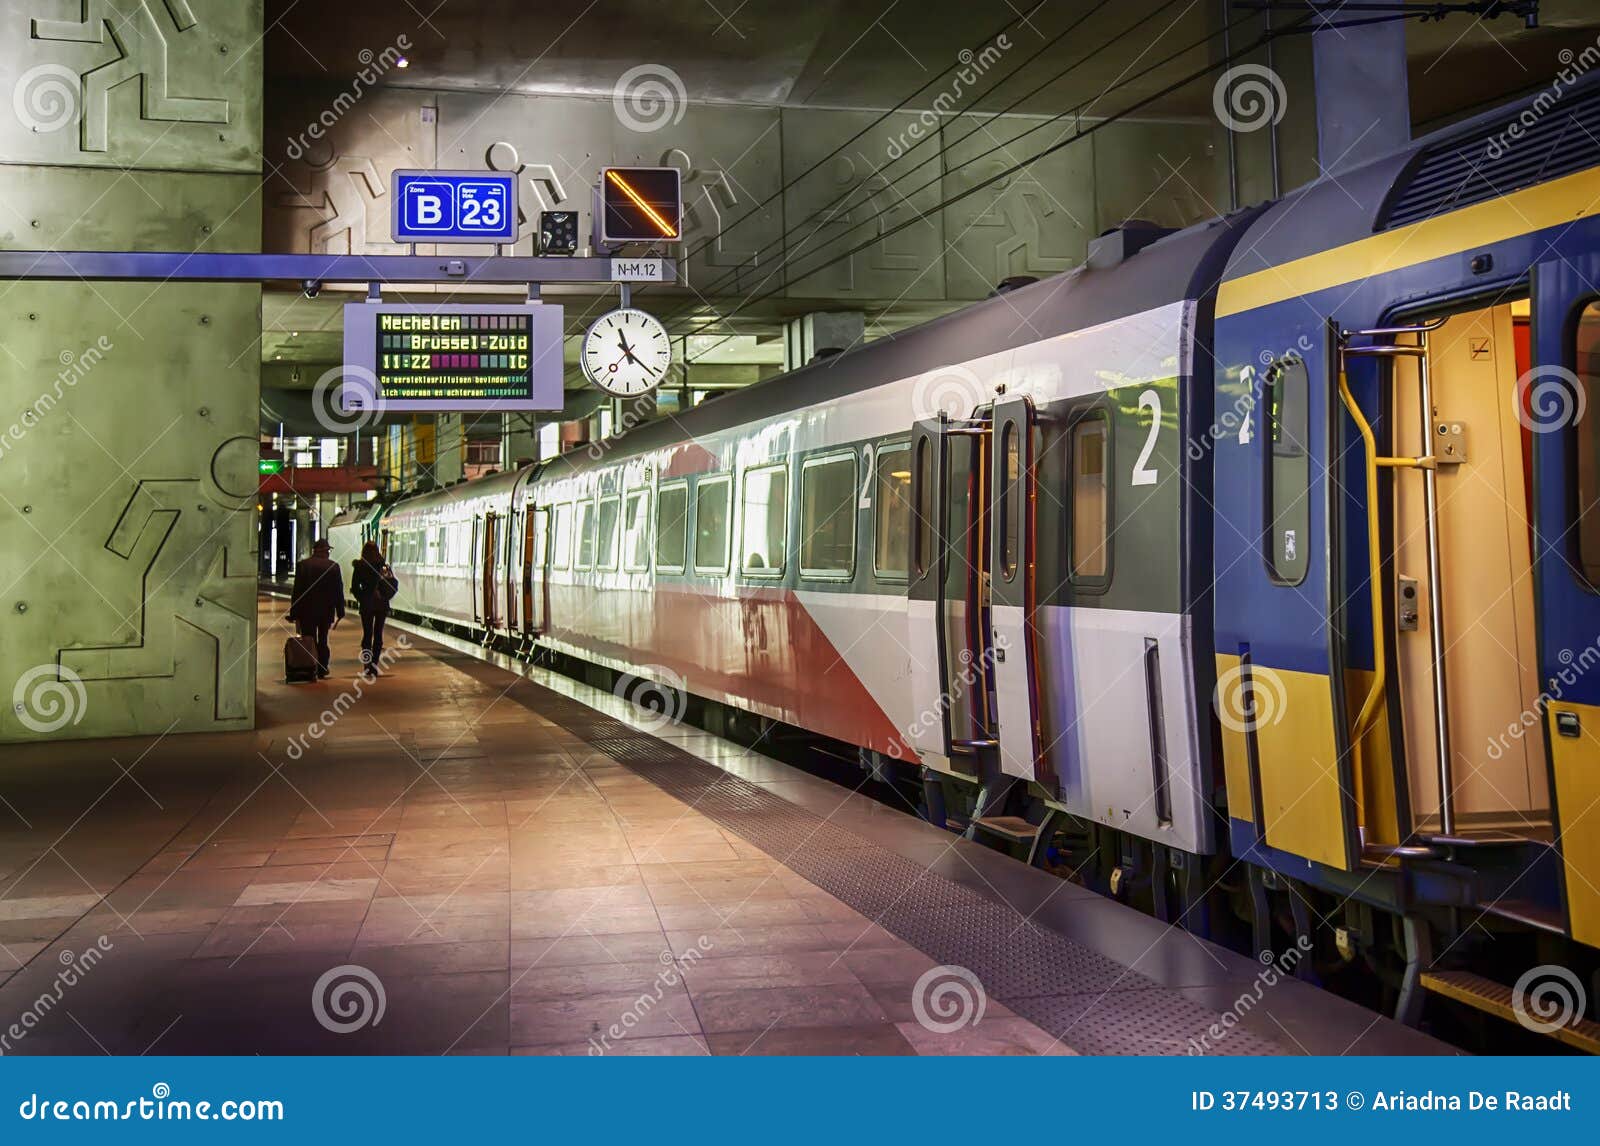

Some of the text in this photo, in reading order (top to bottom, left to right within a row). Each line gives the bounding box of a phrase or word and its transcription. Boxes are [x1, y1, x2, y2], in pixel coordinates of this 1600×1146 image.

[417, 195, 442, 224] B
[462, 199, 501, 225] 23
[618, 263, 656, 276] N-M.12
[382, 315, 460, 330] Mechelen
[411, 335, 527, 350] Brussel-Zuid
[383, 354, 527, 369] 11:22 IC
[1132, 389, 1161, 486] 2
[859, 443, 874, 509] 2
